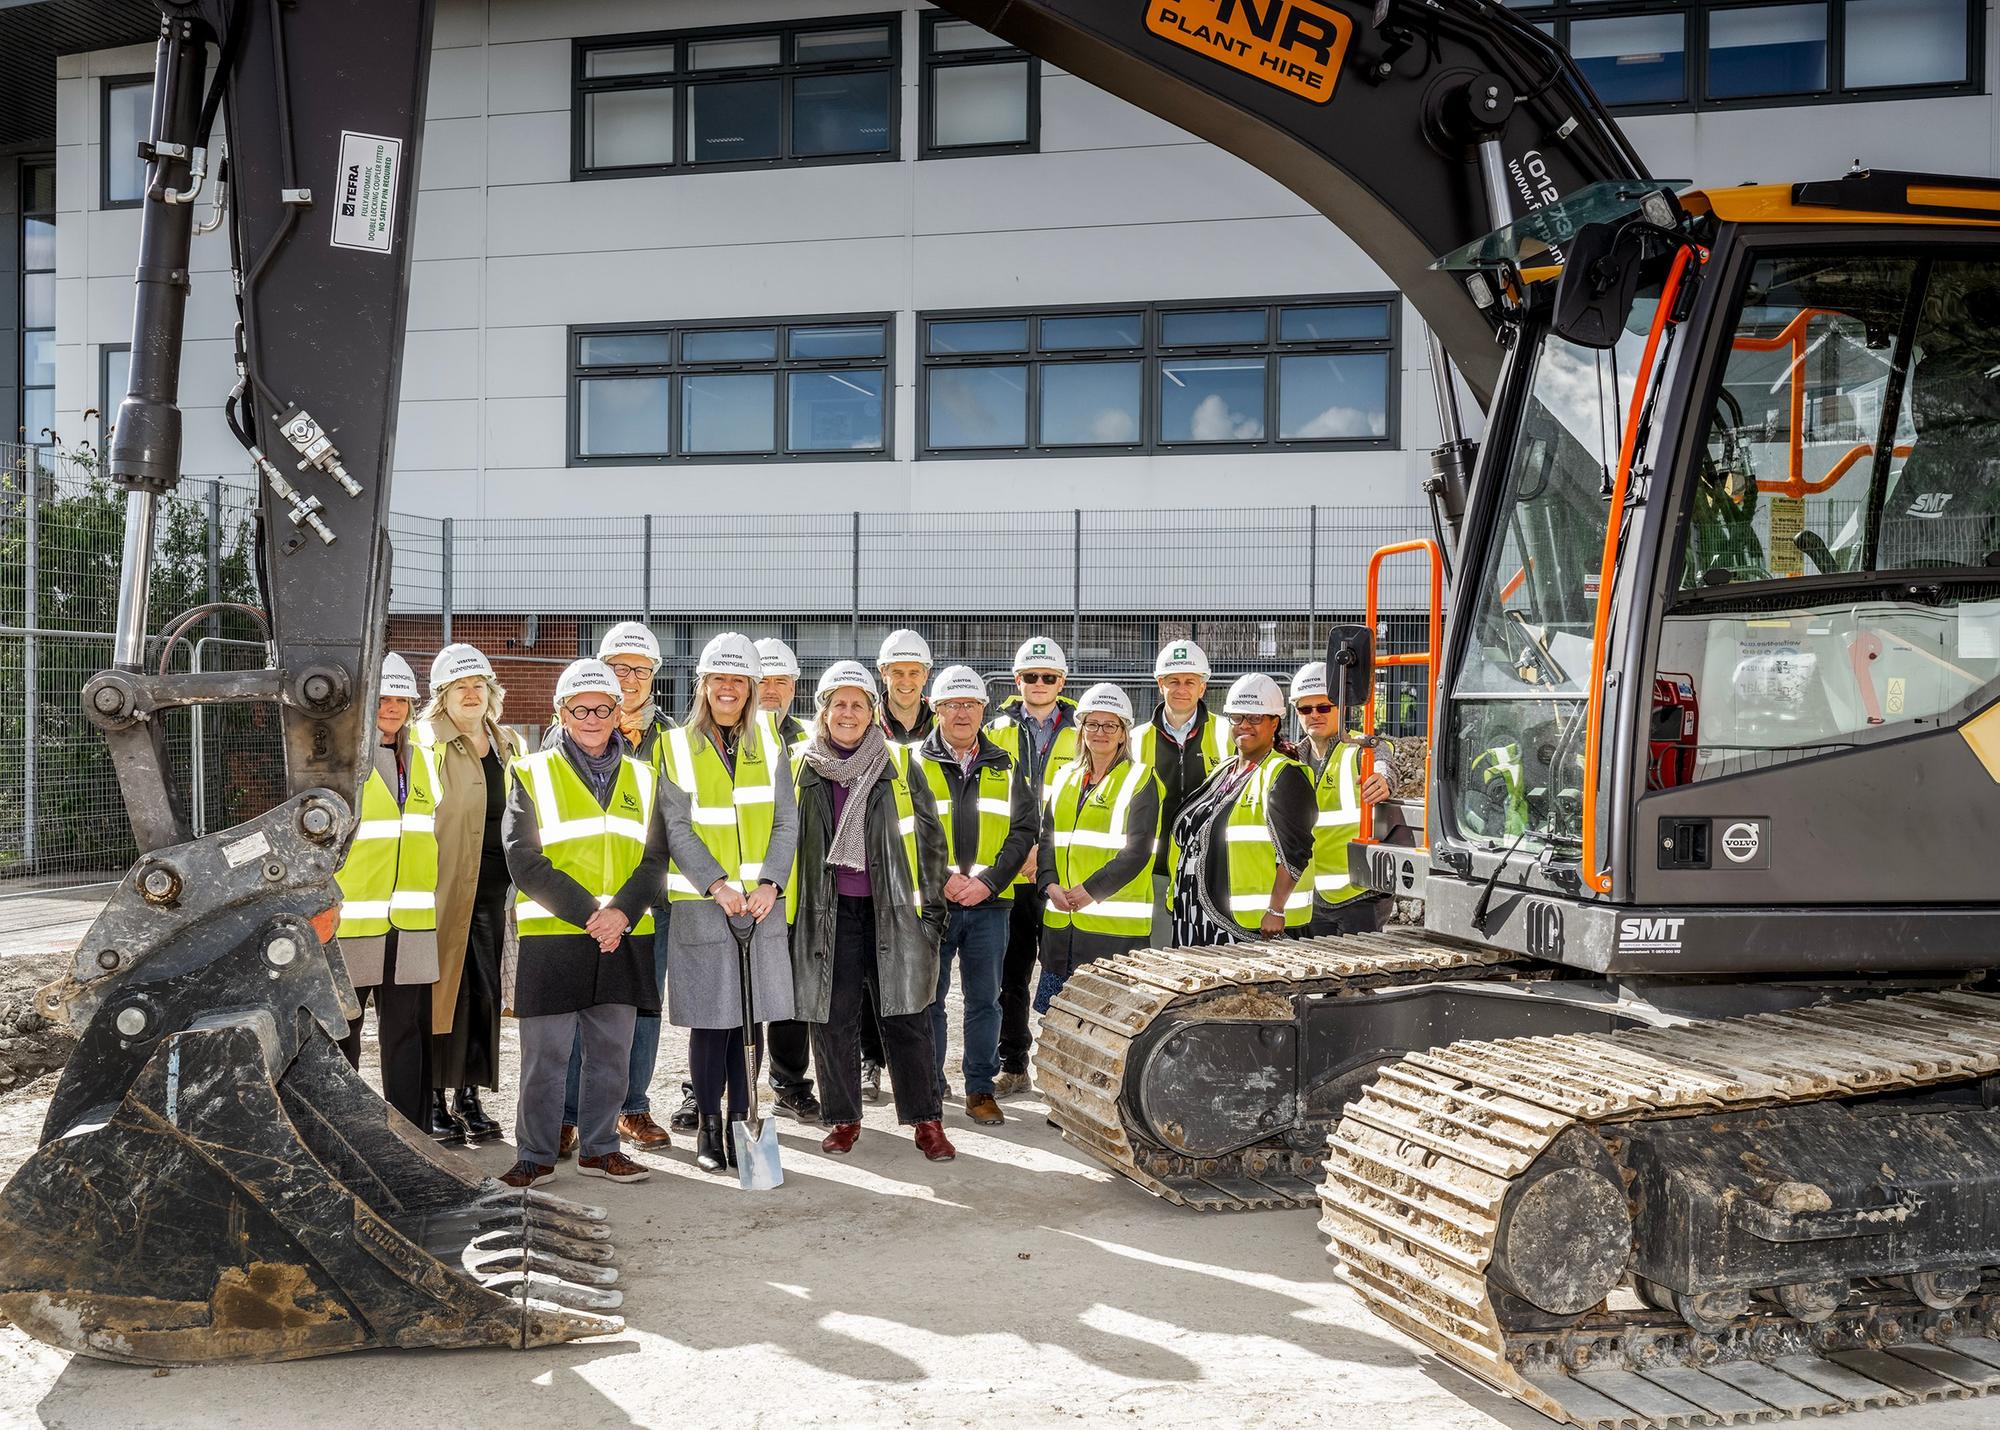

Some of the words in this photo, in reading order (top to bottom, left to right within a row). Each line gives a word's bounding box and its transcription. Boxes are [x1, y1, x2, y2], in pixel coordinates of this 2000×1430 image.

[1167, 0, 1338, 66] NR
[1159, 8, 1253, 57] PLANT
[1259, 51, 1324, 90] HIRE
[375, 145, 384, 163] FITTED
[373, 164, 382, 191] COUPLER
[382, 157, 392, 187] REQUIRED
[346, 164, 359, 203] TEFRA
[362, 166, 373, 199] AUTOMATIC
[381, 188, 389, 199] PIN
[361, 199, 369, 217] FULLY
[370, 192, 379, 217] LOCKING
[379, 201, 388, 221] SAFETY
[368, 218, 377, 241] DOUBLE
[379, 222, 385, 232] NO
[1910, 492, 1953, 512] SMT
[615, 641, 650, 650] SUNNINGHILL
[449, 664, 485, 675] SUNNINGHILL
[456, 657, 478, 665] VISITOR
[712, 660, 749, 669] SUNNINGHILL
[572, 679, 611, 688] SUNNINGHILL
[833, 676, 868, 684] SUNNINGHILL
[1092, 700, 1124, 709] SUNNINGHILL
[1620, 918, 1685, 940] SMT
